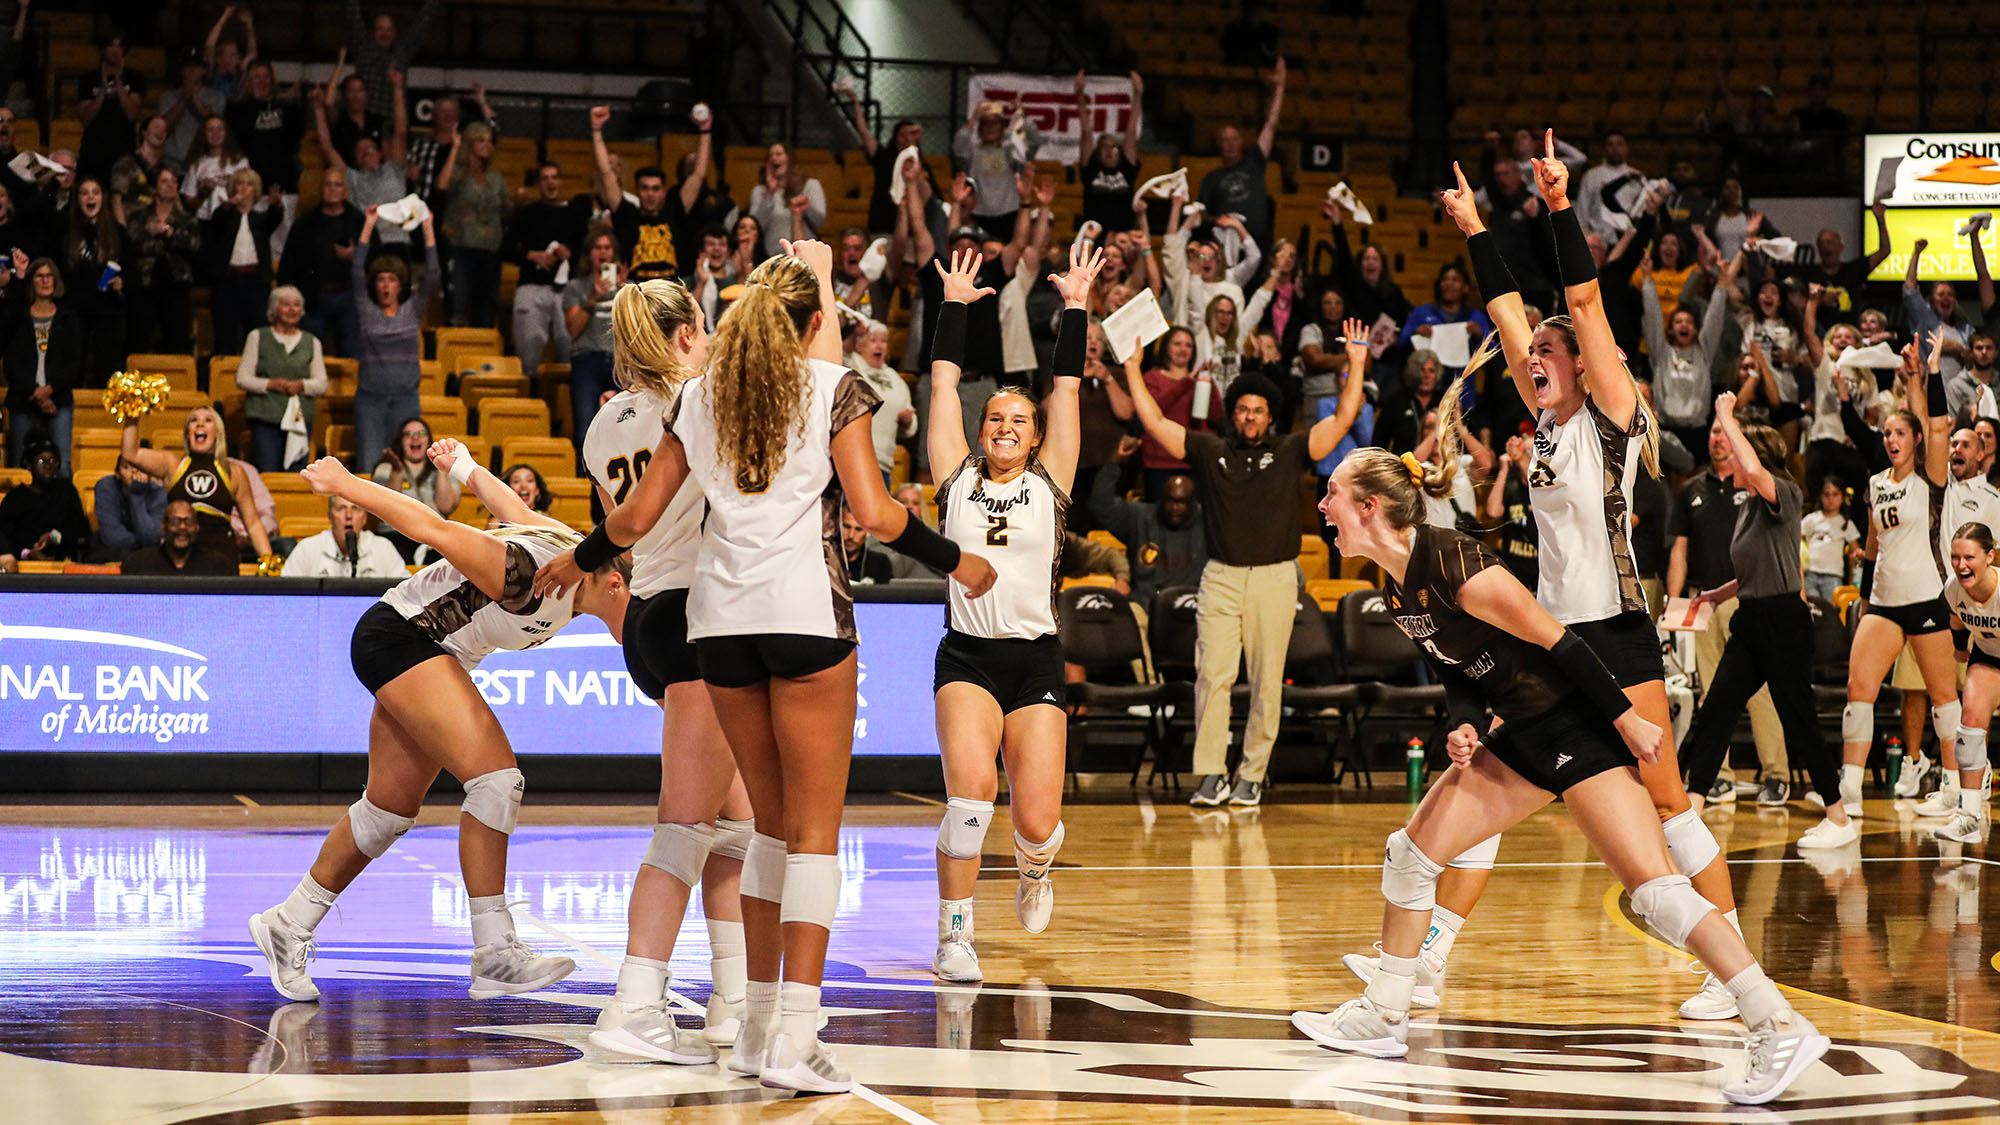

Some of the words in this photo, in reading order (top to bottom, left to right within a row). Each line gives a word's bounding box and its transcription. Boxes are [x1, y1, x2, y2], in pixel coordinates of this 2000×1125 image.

[416, 99, 434, 121] C
[1313, 145, 1330, 165] D
[1874, 253, 1998, 275] GRENLEF
[191, 475, 212, 493] W
[1880, 506, 1901, 530] 16
[986, 514, 1009, 547] 2
[1, 664, 84, 700] NAL
[96, 665, 210, 701] BANK
[41, 703, 72, 742] of
[74, 703, 209, 743] Michigan
